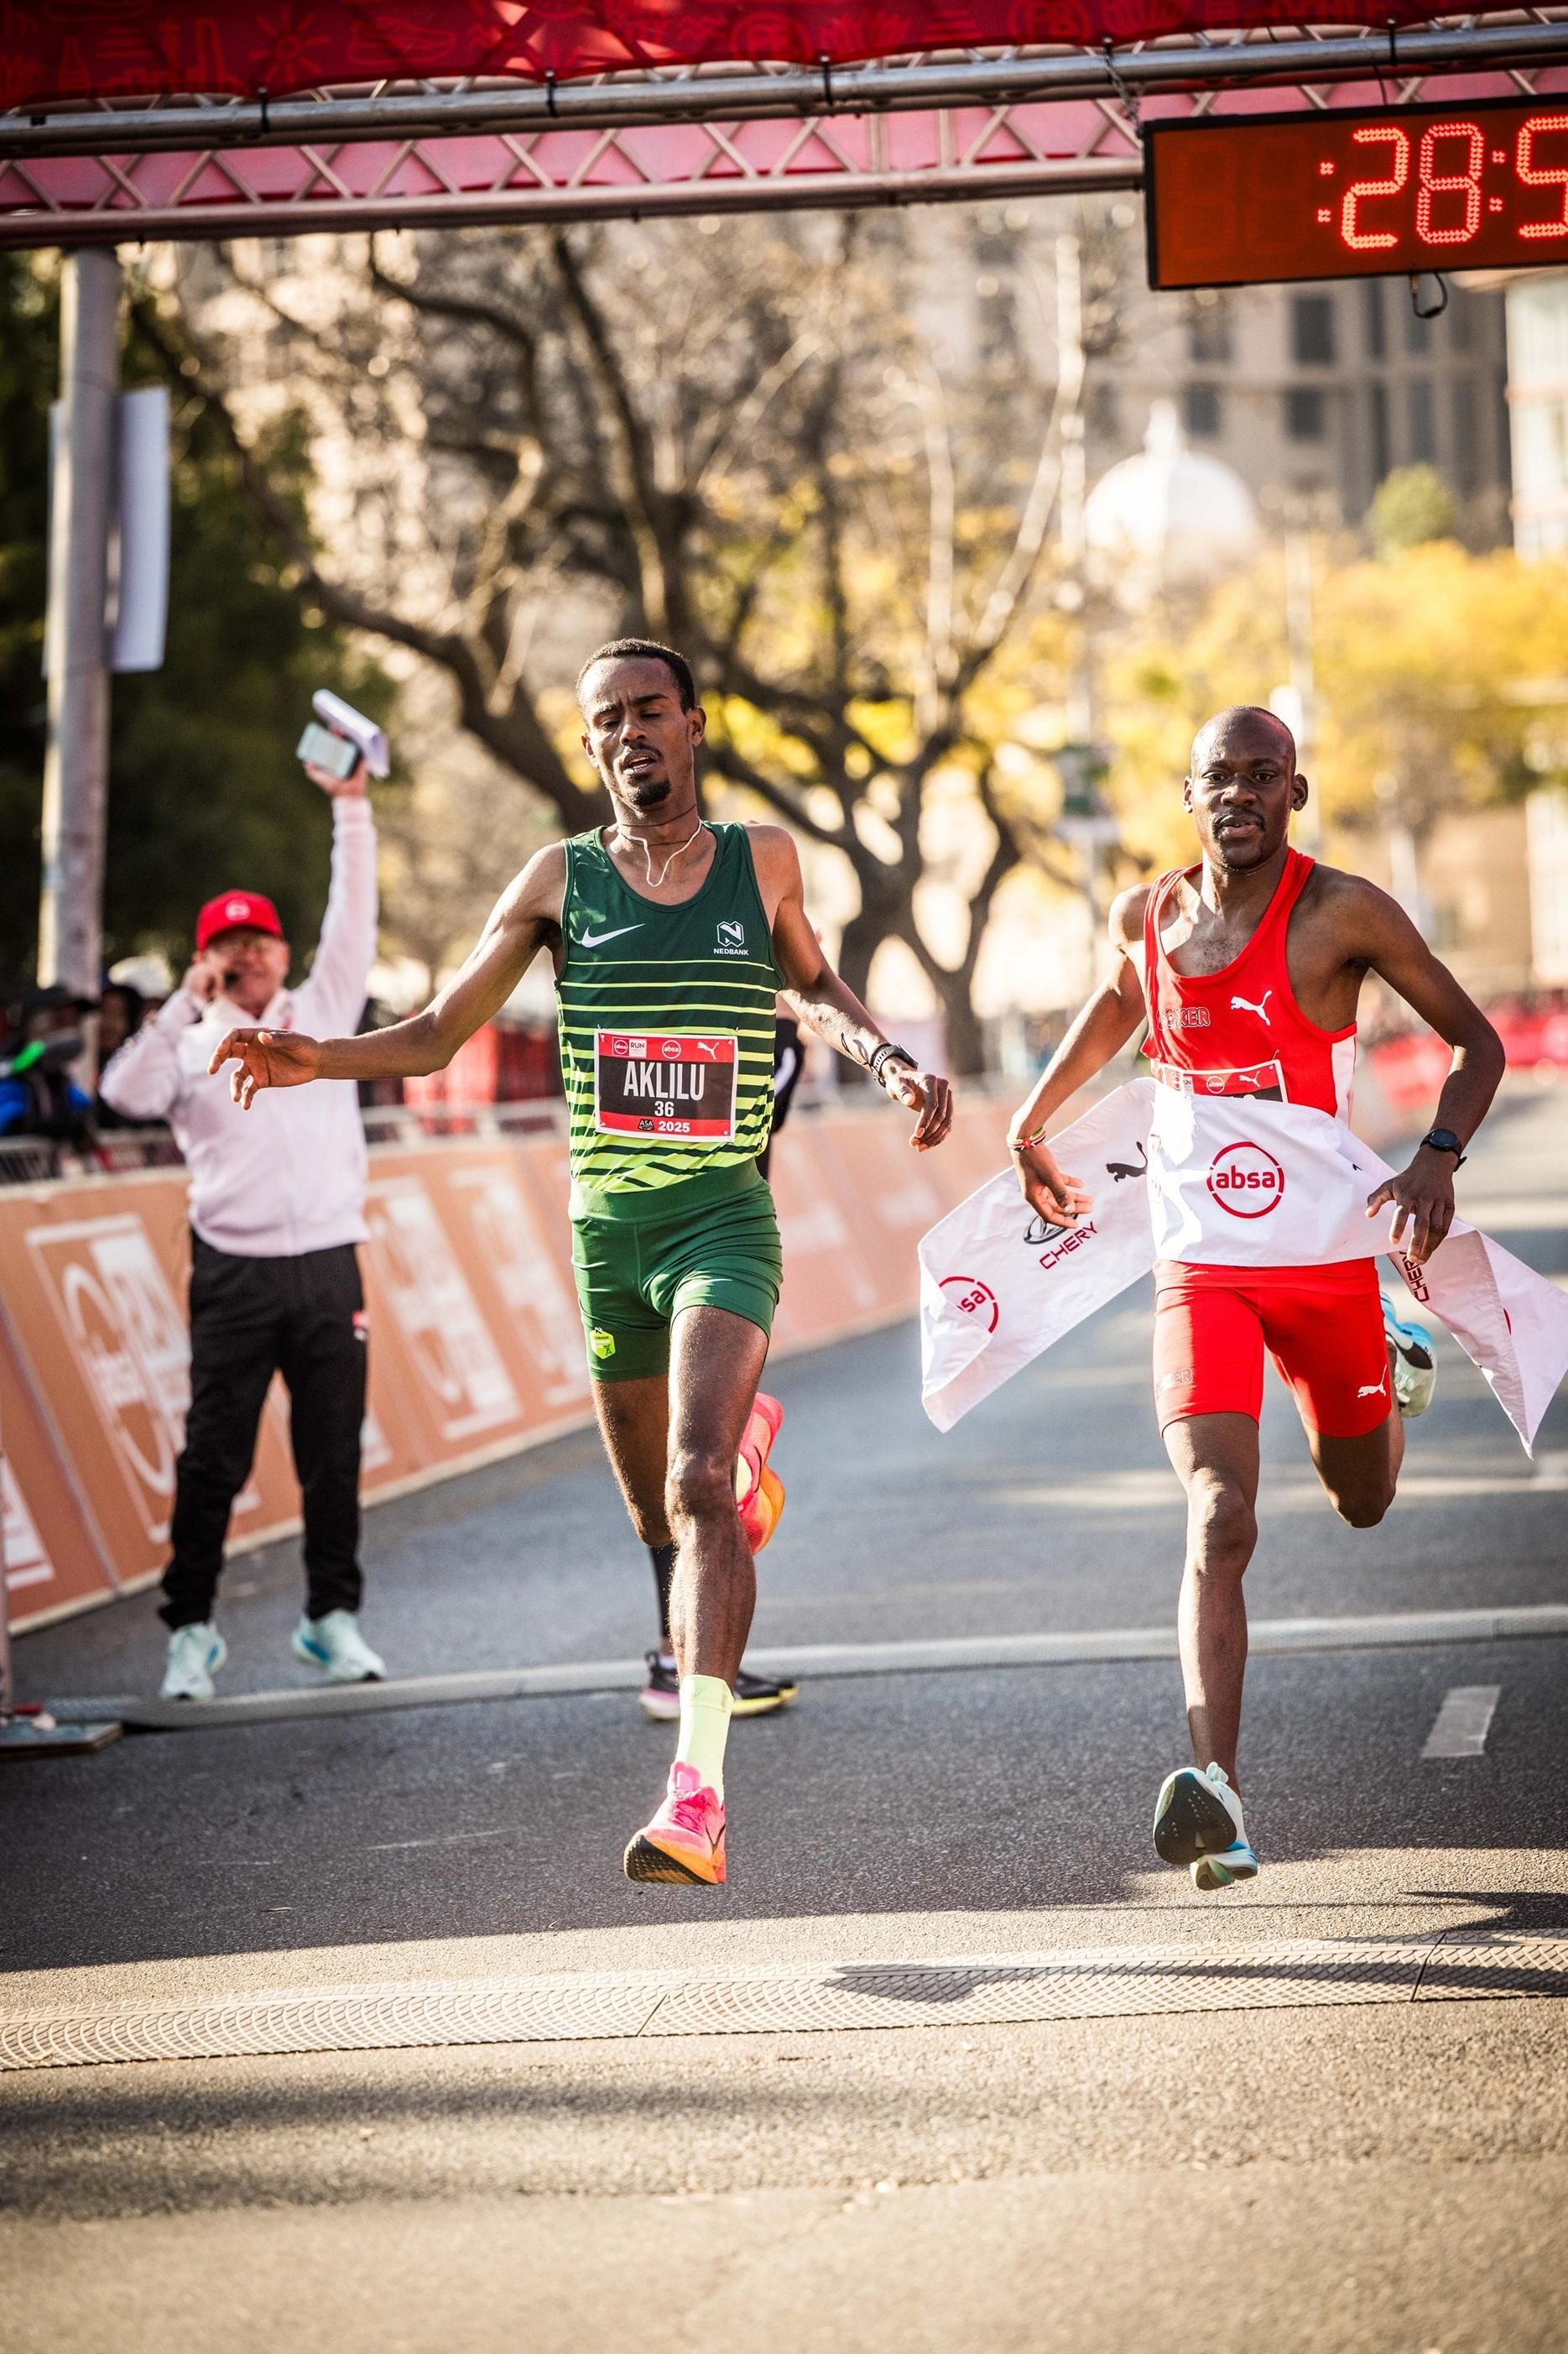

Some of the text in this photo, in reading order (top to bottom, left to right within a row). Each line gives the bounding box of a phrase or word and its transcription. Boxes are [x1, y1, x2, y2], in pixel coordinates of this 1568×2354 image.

[623, 1061, 705, 1101] AKLILU
[654, 1101, 675, 1117] 36
[658, 1120, 690, 1133] 2025
[1216, 1165, 1275, 1189] absa
[1039, 1221, 1098, 1270] CHERY
[956, 1289, 987, 1313] sa
